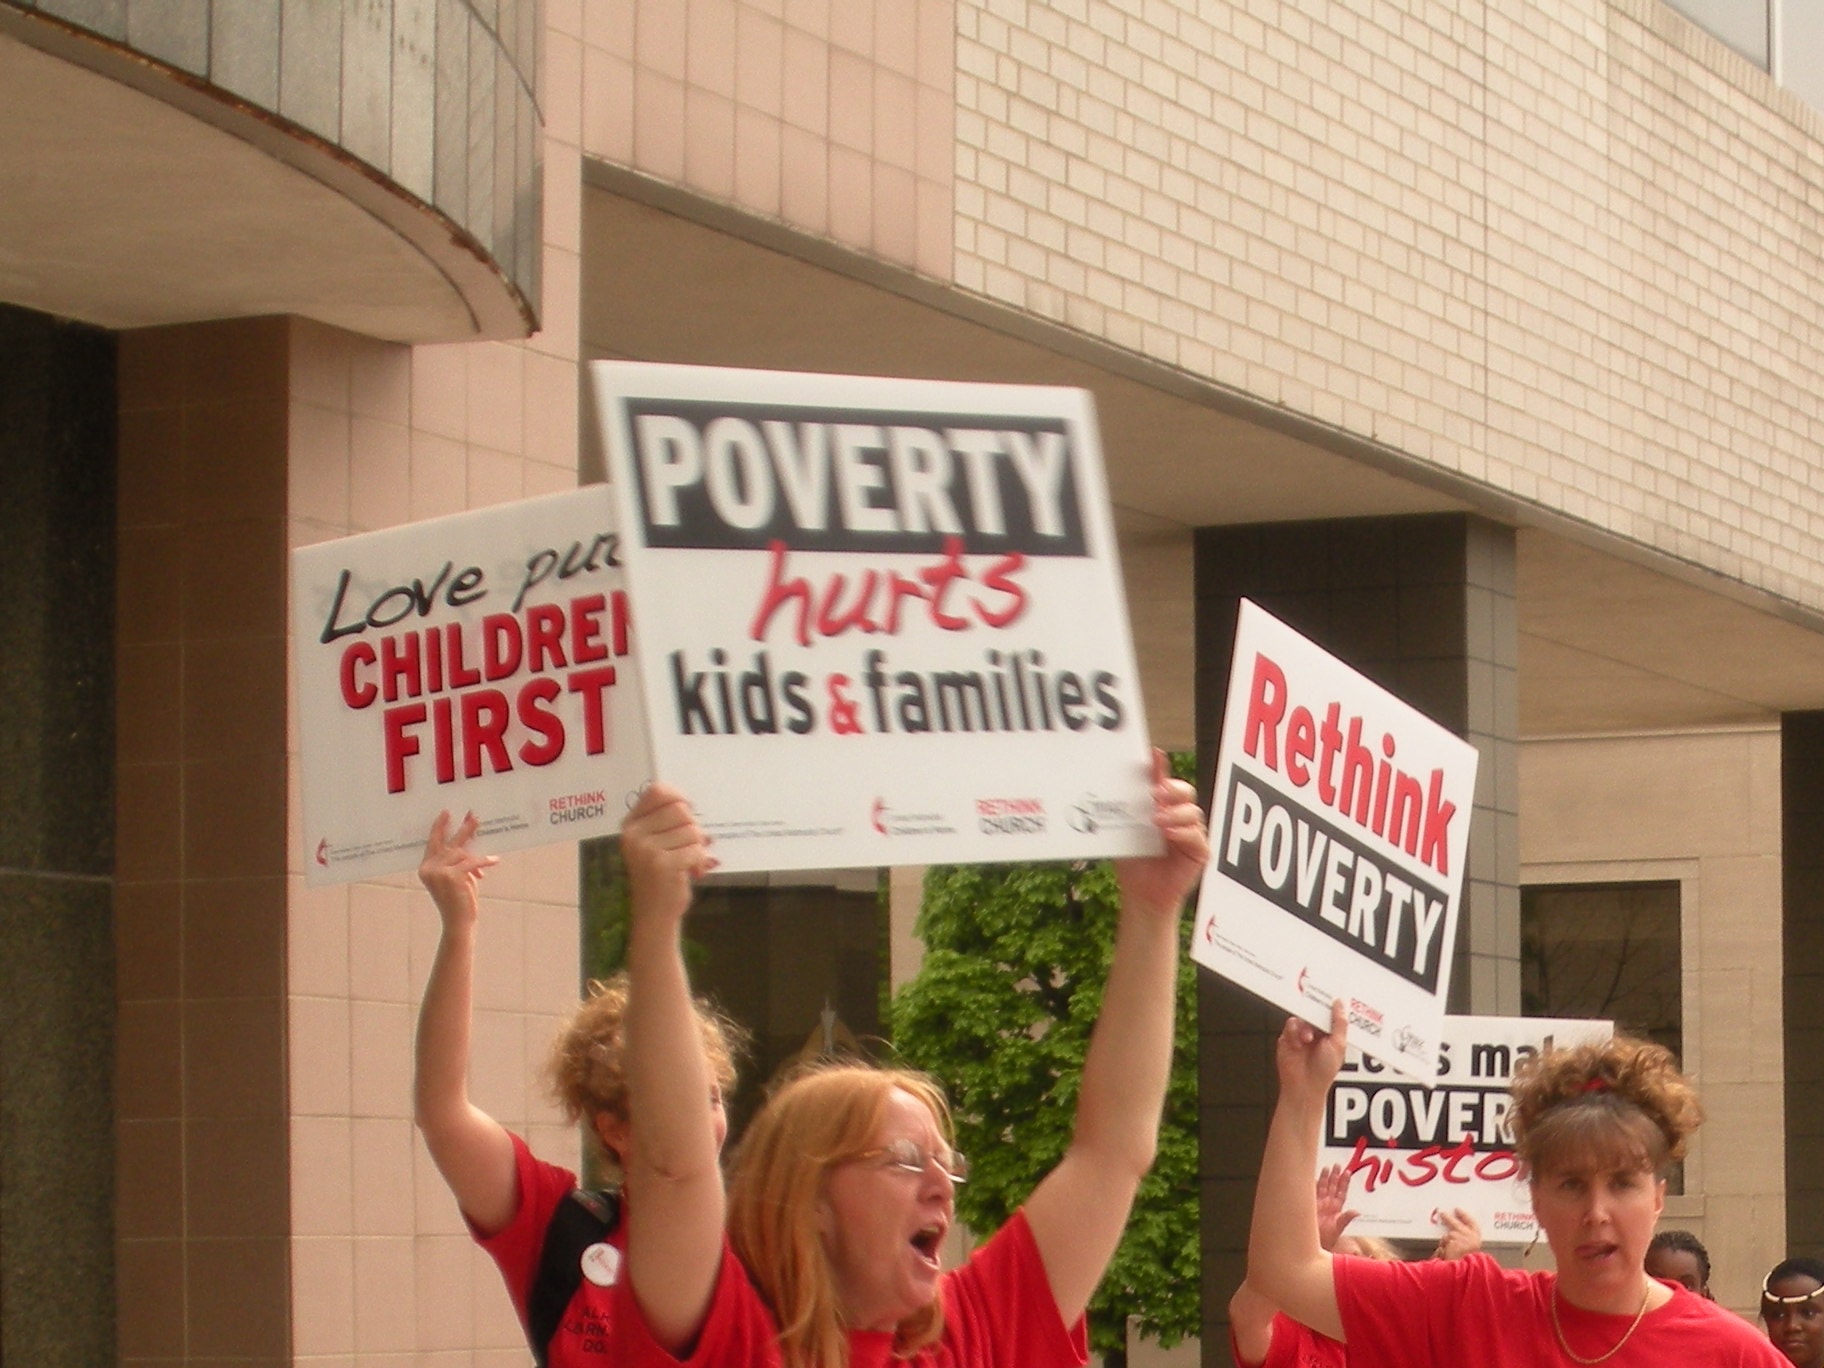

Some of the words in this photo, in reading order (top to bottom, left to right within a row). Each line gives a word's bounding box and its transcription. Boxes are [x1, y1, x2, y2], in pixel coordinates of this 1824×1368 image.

[634, 413, 1070, 537] POVERTY
[320, 560, 488, 644] Love
[749, 536, 1030, 648] hurts
[383, 666, 617, 794] FIRST
[670, 648, 818, 736] kids
[863, 648, 1127, 735] families
[549, 790, 606, 810] RETHINK
[550, 804, 604, 825] CHURCH
[1243, 651, 1456, 878] Rethink
[1226, 779, 1445, 977] POVERTY
